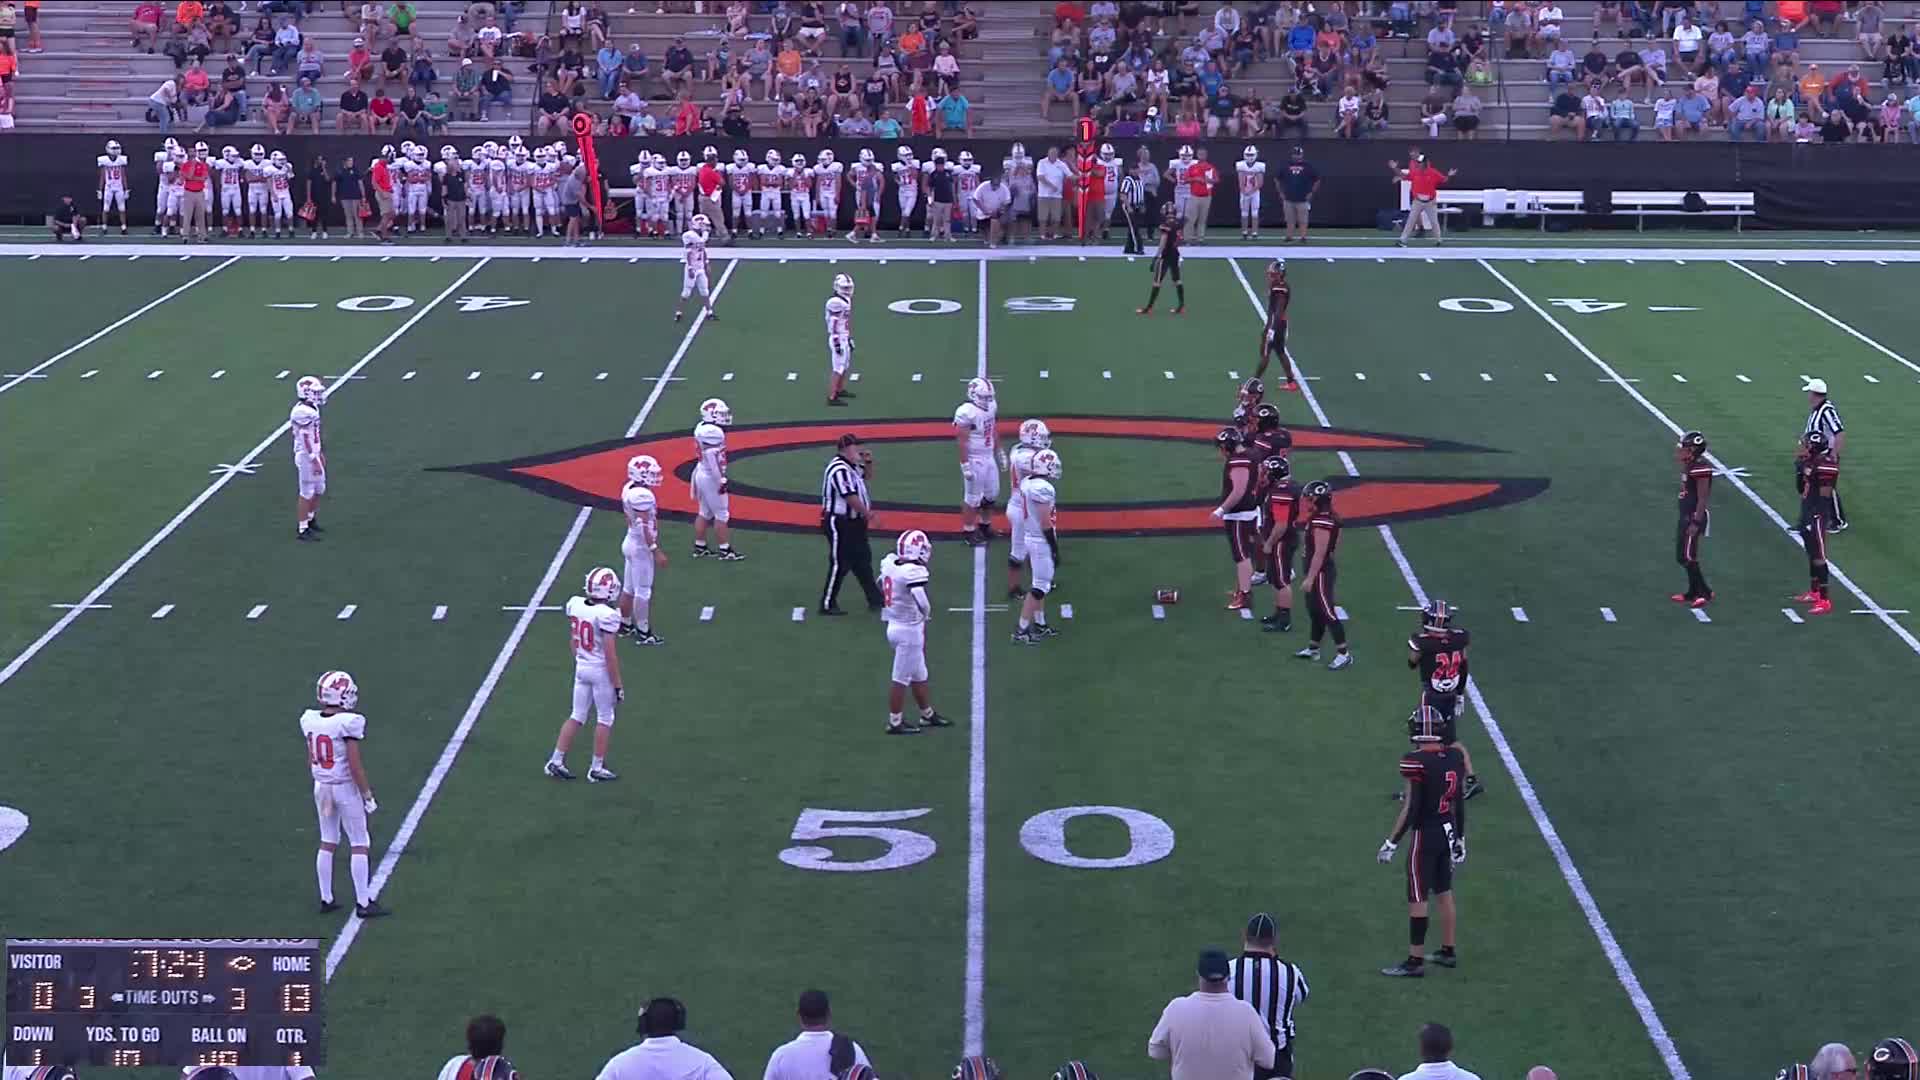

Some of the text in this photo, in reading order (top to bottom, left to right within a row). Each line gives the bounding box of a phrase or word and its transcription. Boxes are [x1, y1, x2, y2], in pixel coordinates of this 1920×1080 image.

[569, 616, 594, 652] 20
[306, 731, 335, 770] 10
[1437, 770, 1457, 814] 2
[778, 805, 1175, 872] 50
